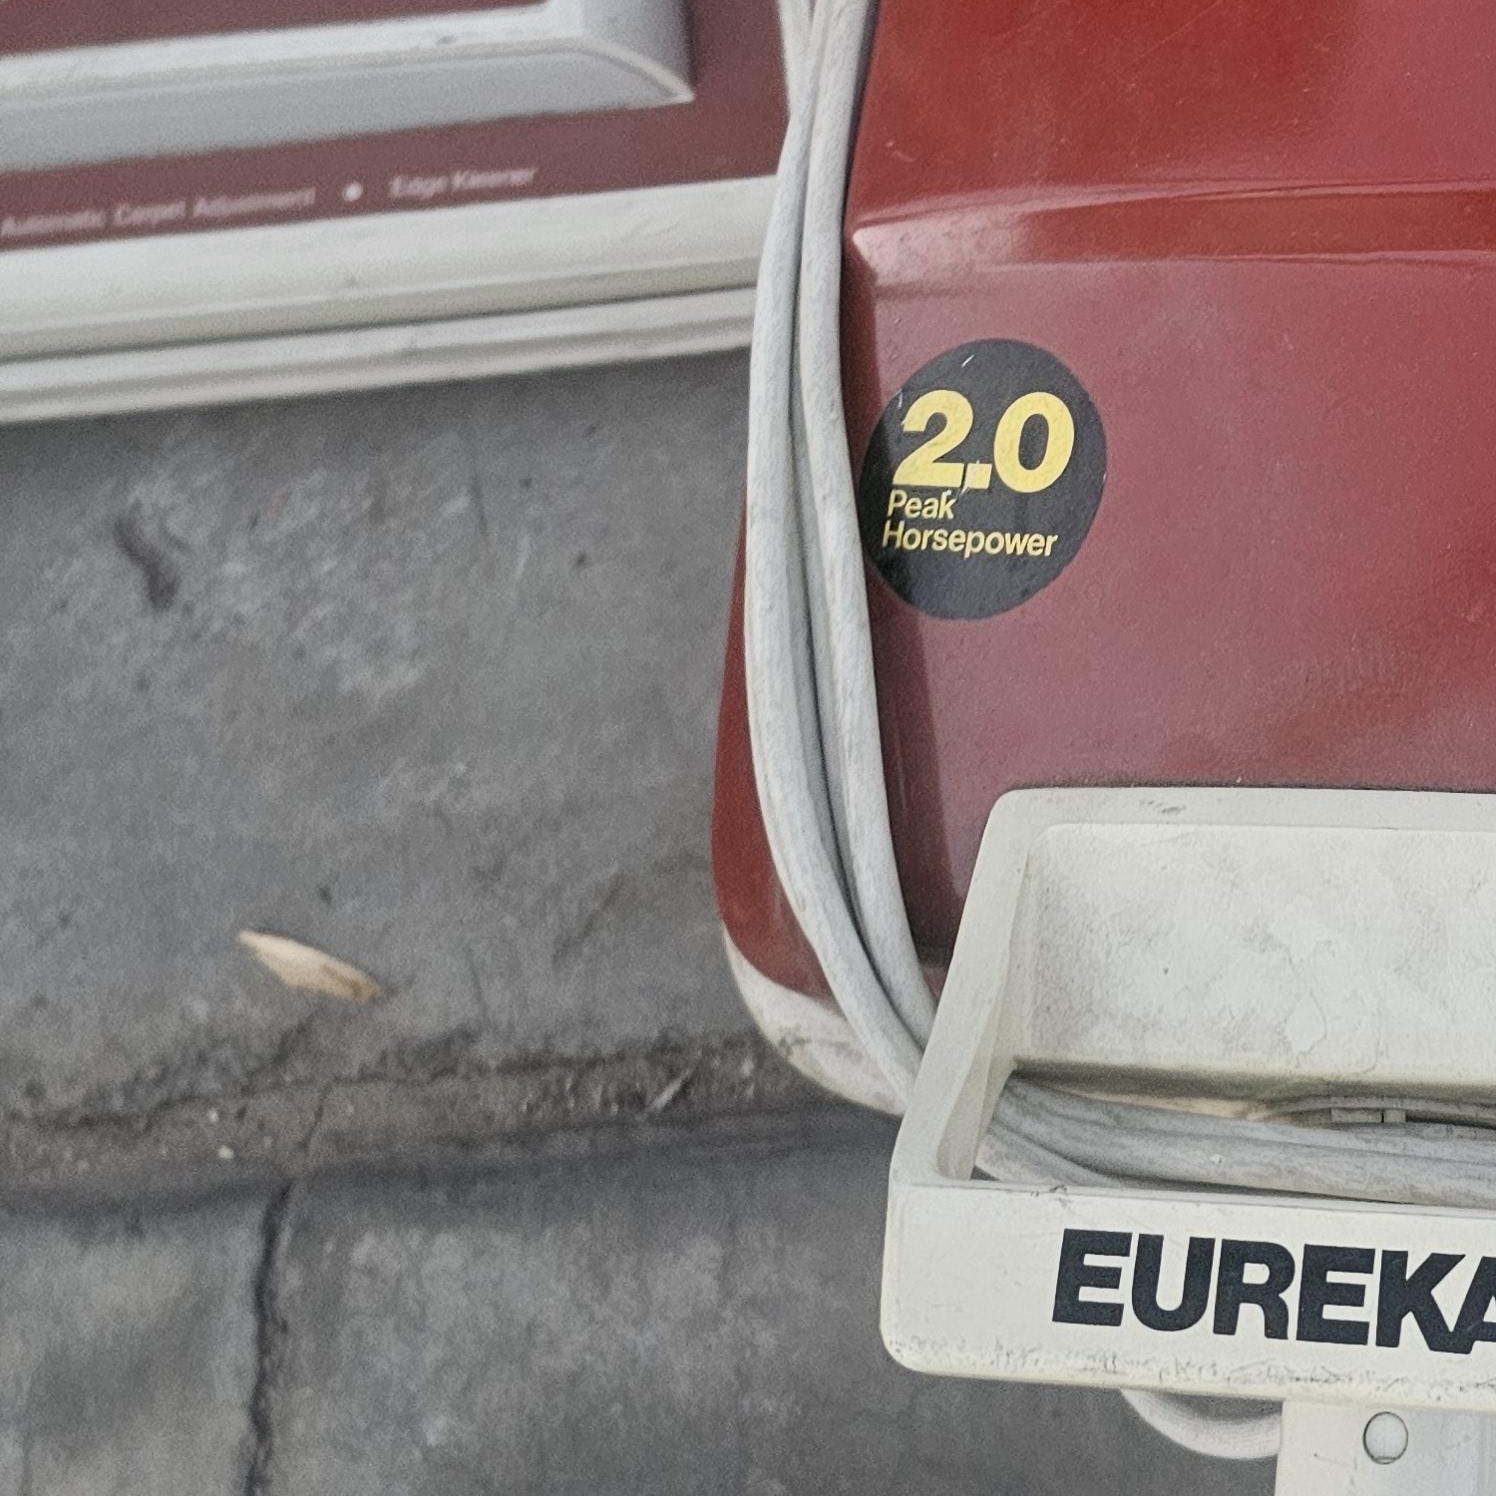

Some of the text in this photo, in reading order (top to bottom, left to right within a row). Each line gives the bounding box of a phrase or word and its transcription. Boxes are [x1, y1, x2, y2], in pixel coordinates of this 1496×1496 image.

[892, 389, 1075, 493] 2.0
[886, 489, 957, 519] Peak
[882, 519, 1058, 559] Horsepower
